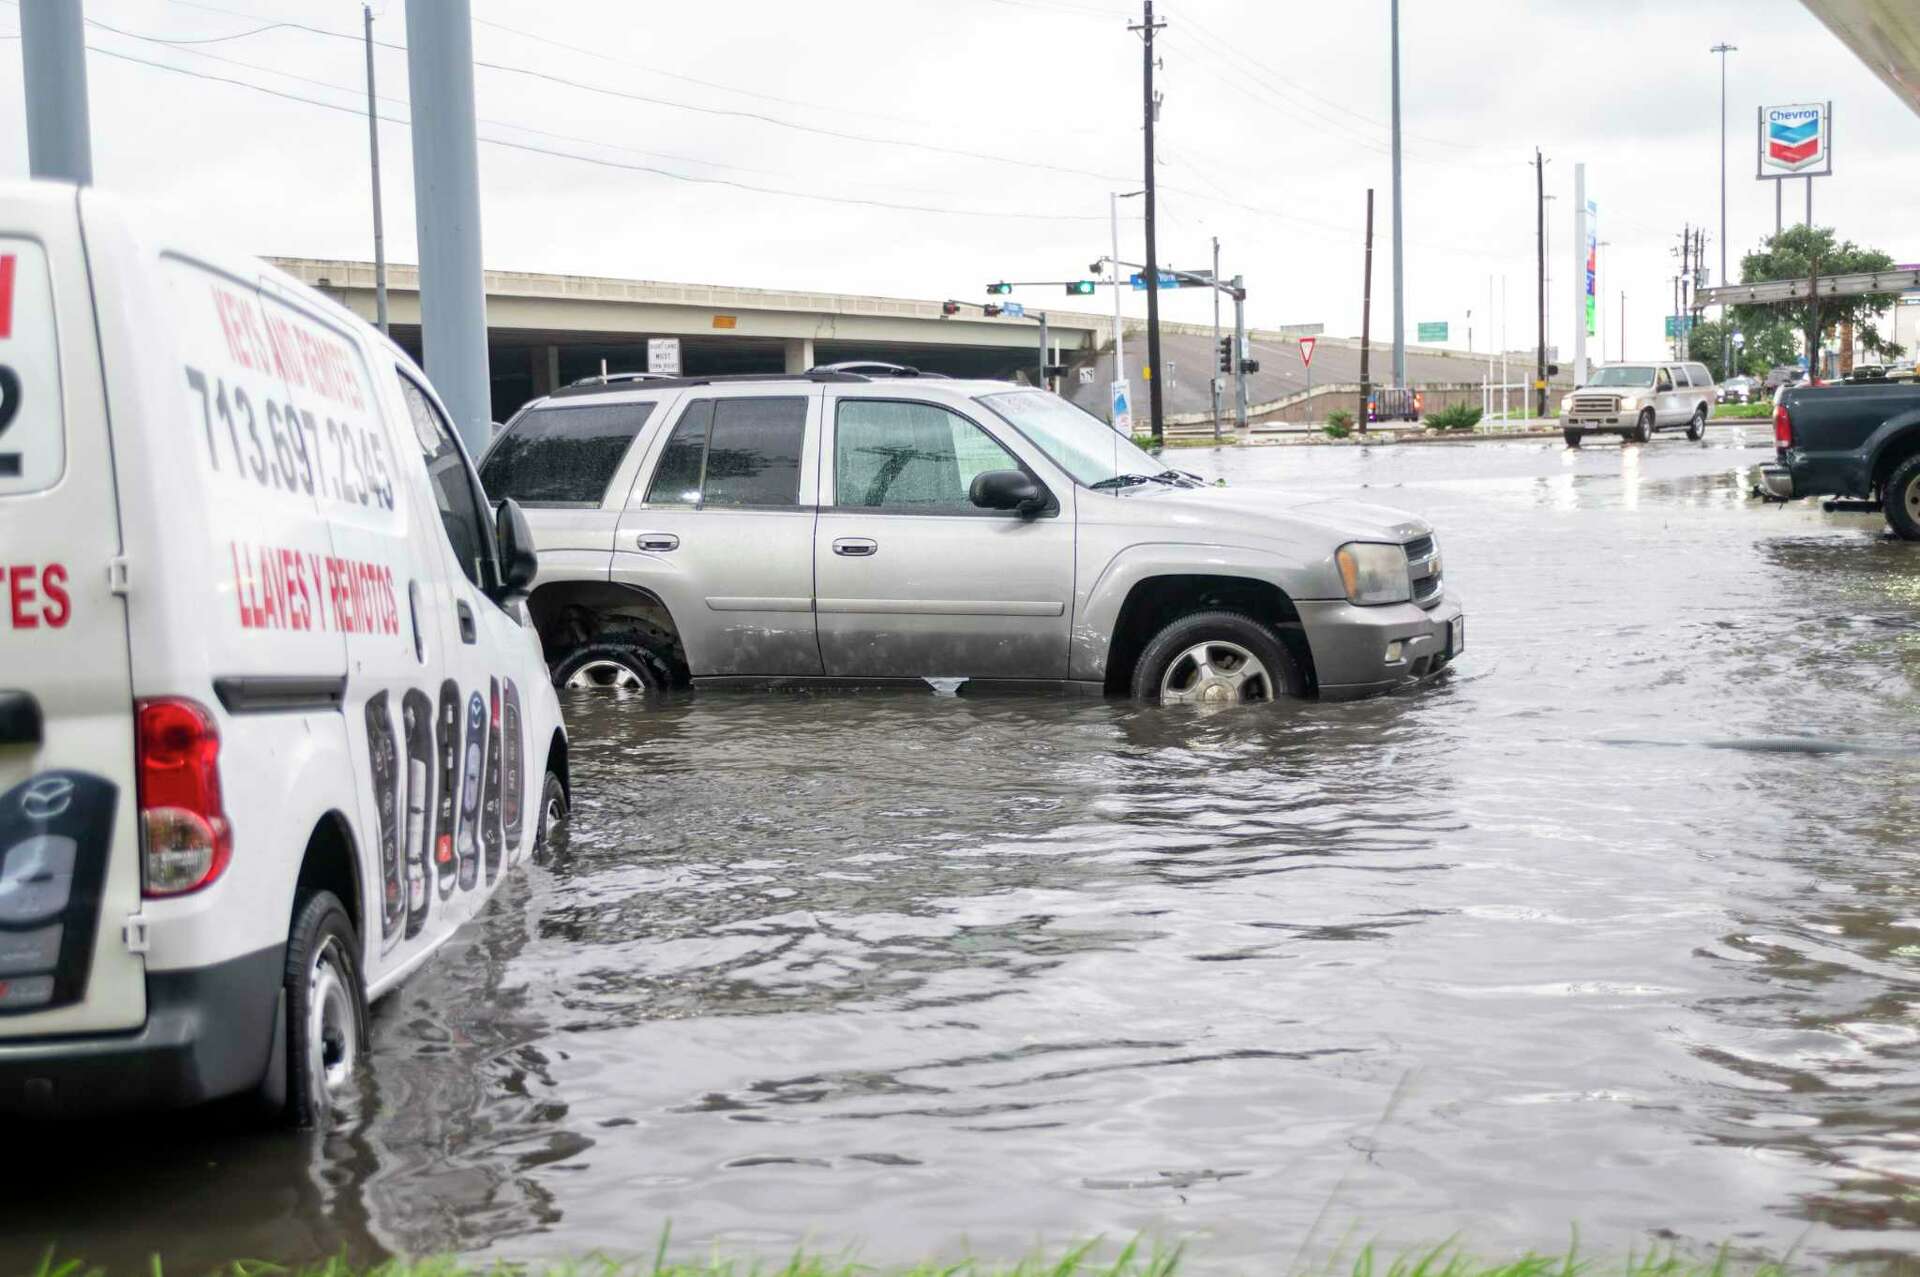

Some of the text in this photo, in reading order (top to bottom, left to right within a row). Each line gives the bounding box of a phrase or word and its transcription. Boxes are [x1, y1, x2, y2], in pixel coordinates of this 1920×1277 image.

[1769, 110, 1819, 121] Chevron
[185, 364, 394, 512] 713.697.2345
[0, 563, 71, 628] ES
[231, 541, 399, 635] LLAVES Y REMOTOS
